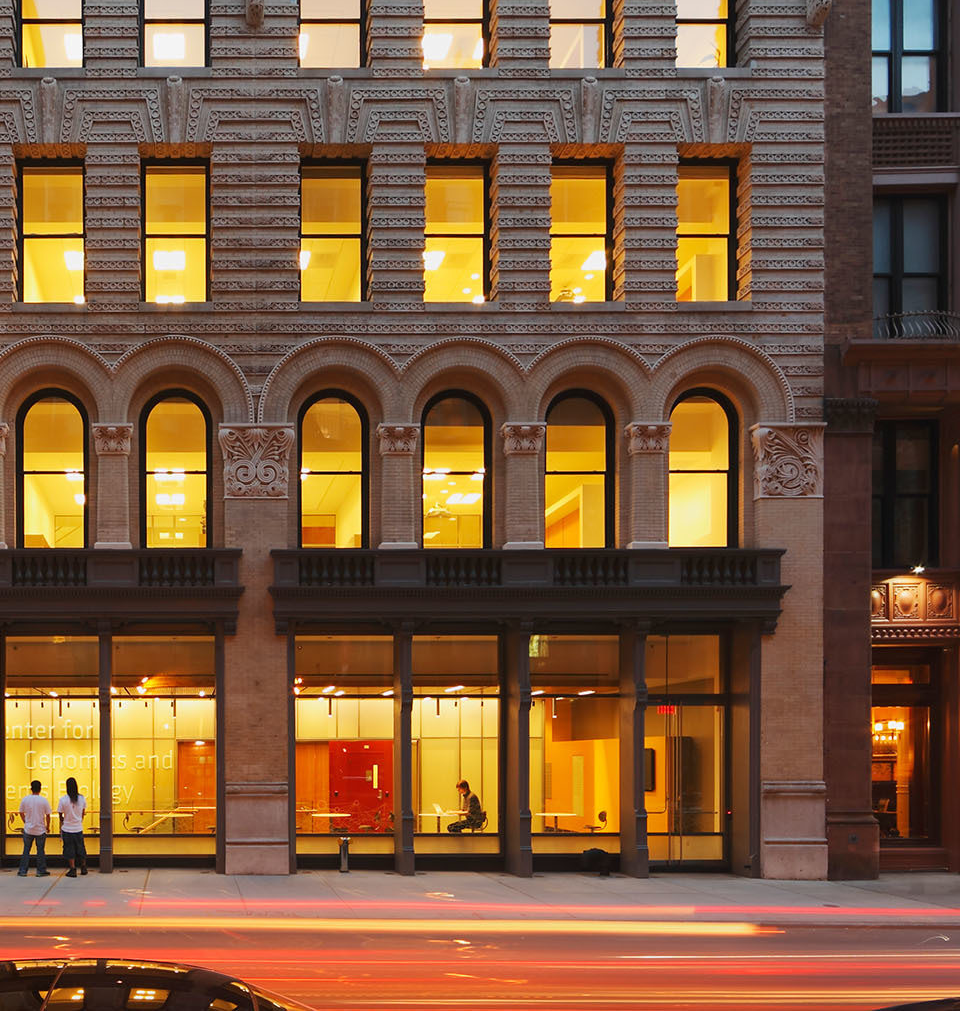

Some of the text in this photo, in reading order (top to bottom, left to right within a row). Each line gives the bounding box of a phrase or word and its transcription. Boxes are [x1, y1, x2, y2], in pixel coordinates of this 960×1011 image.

[5, 722, 55, 739] nter
[62, 719, 94, 739] for
[24, 750, 173, 770] Genoms and
